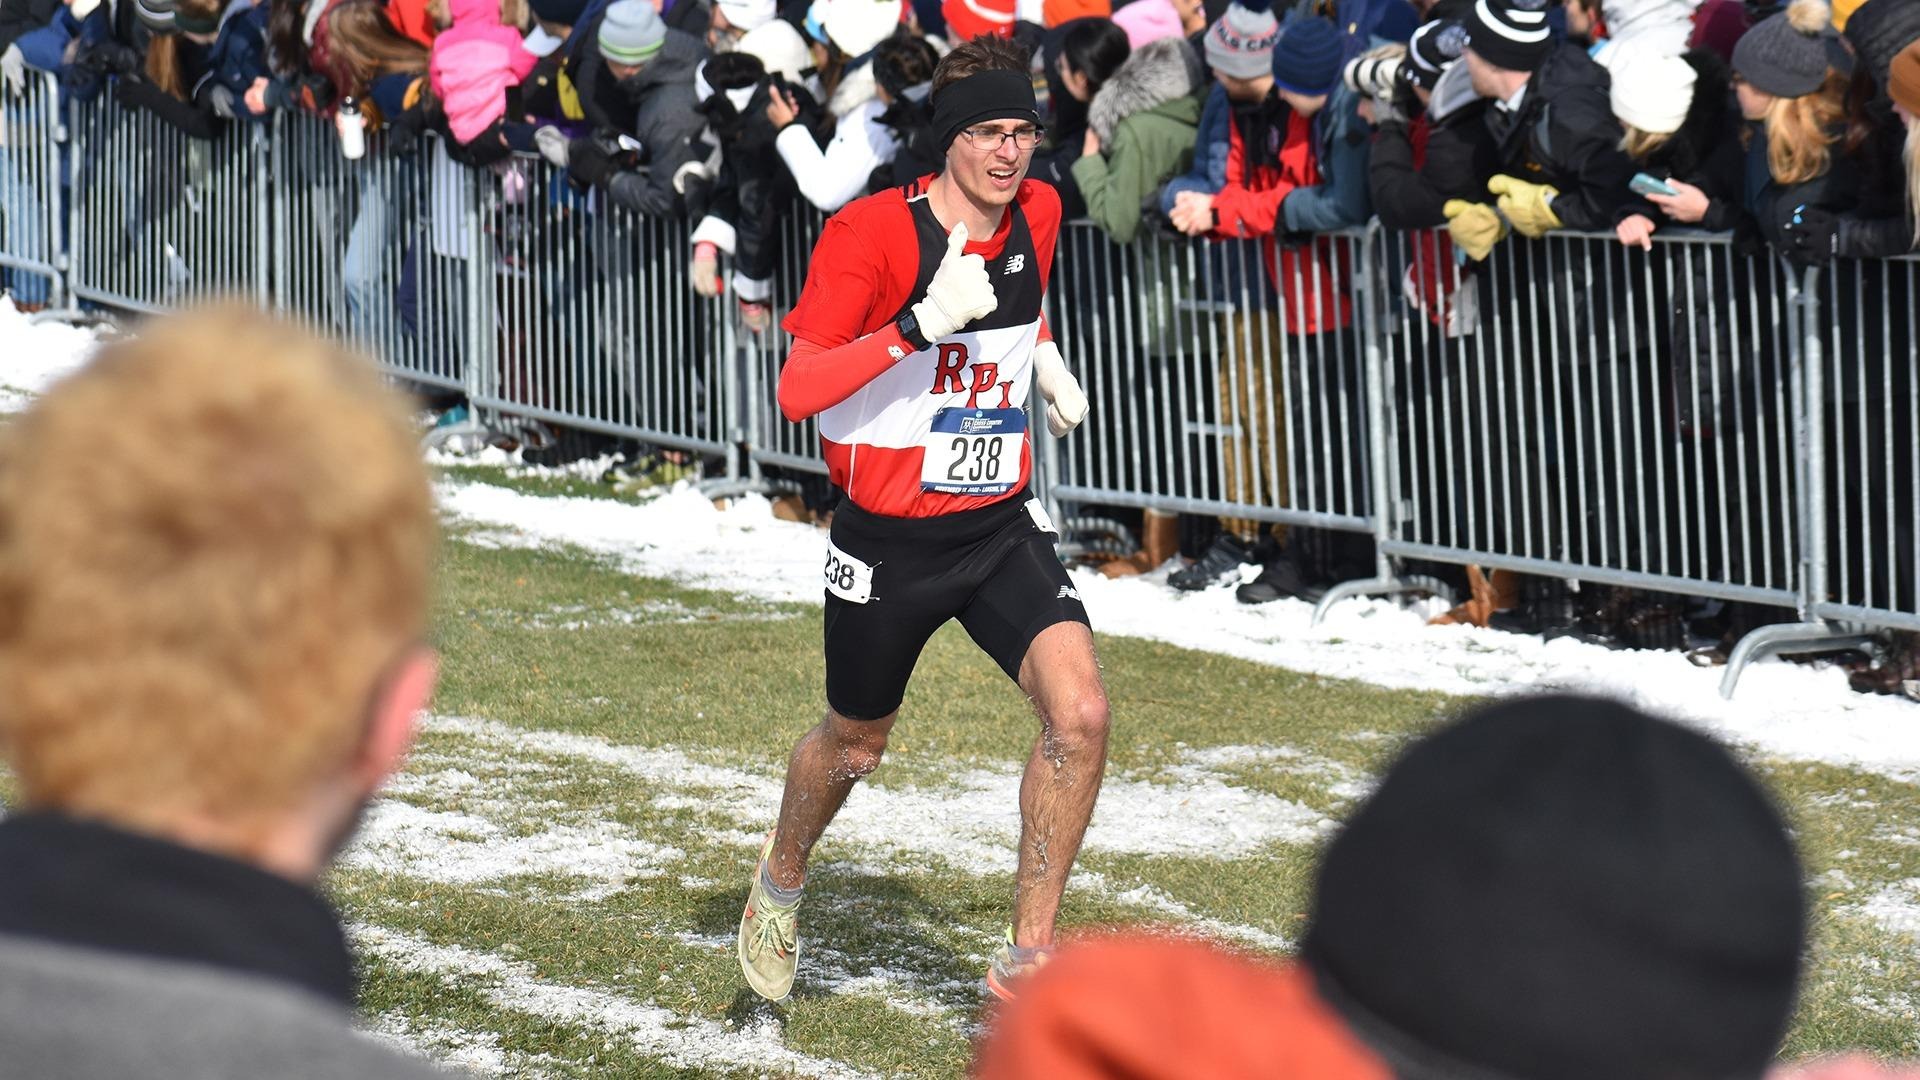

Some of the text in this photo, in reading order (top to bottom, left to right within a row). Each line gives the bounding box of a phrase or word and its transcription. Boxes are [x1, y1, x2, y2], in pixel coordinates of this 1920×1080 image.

[930, 342, 1014, 410] RPI
[947, 436, 1003, 481] 238
[824, 548, 855, 591] 238
